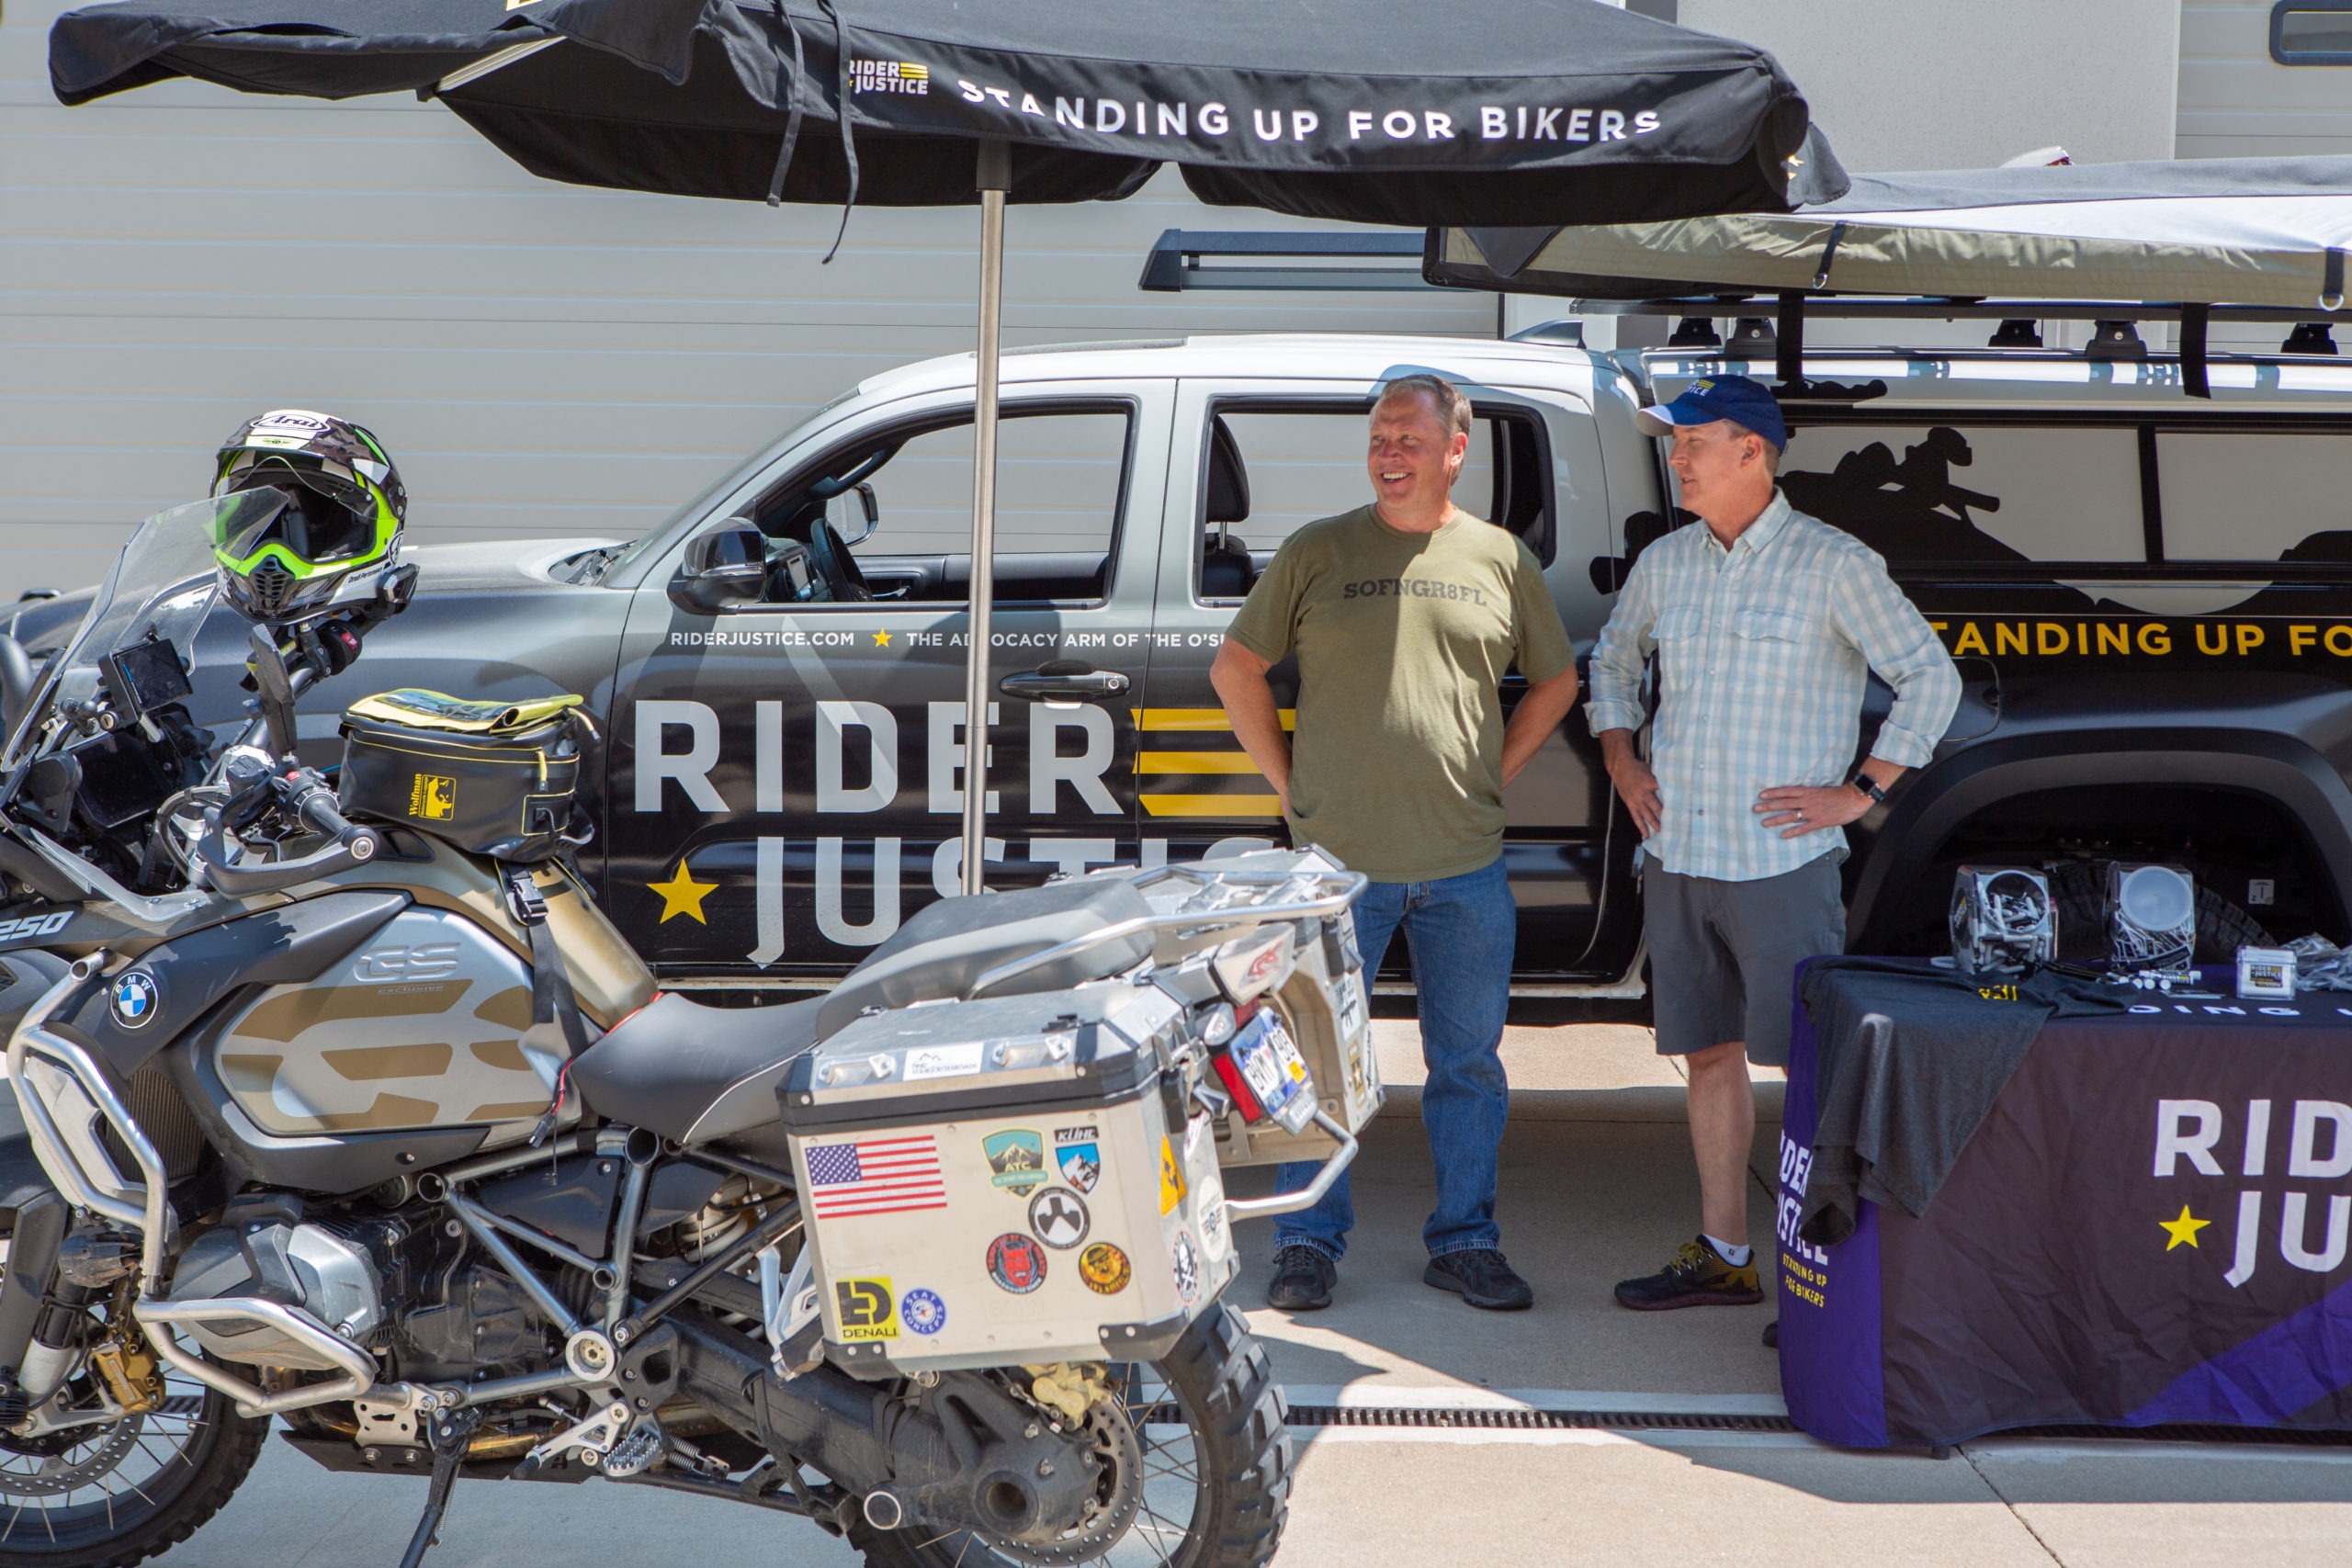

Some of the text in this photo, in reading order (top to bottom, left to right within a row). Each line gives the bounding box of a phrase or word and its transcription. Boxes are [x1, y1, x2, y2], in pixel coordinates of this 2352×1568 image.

[854, 76, 929, 96] JUSTICE
[957, 79, 1661, 142] STANDING UP FOR BIKERS
[273, 416, 318, 428] Arai
[1343, 579, 1487, 606] SOFNGR8FL
[671, 632, 854, 646] RIDERJUSTICE.COM
[907, 633, 943, 646] THE
[949, 633, 1058, 647] AOCACY
[1065, 634, 1105, 647] ARM
[1113, 634, 1139, 647] OF
[1145, 634, 1182, 647] THE
[2196, 624, 2266, 656] UP
[2290, 625, 2352, 657] FO
[635, 700, 1124, 815] RIDER
[409, 773, 422, 816] Wolfman
[354, 942, 460, 982] GS
[115, 976, 153, 994] BMW
[378, 984, 445, 996] exclusive
[2153, 1099, 2352, 1178] RID
[1004, 1161, 1032, 1173] ATC
[1815, 1271, 1827, 1288] UP
[1796, 1282, 1826, 1309] BIKERS
[904, 1291, 944, 1333] SEAT CONCEPTS
[842, 1327, 898, 1338] DENALI
